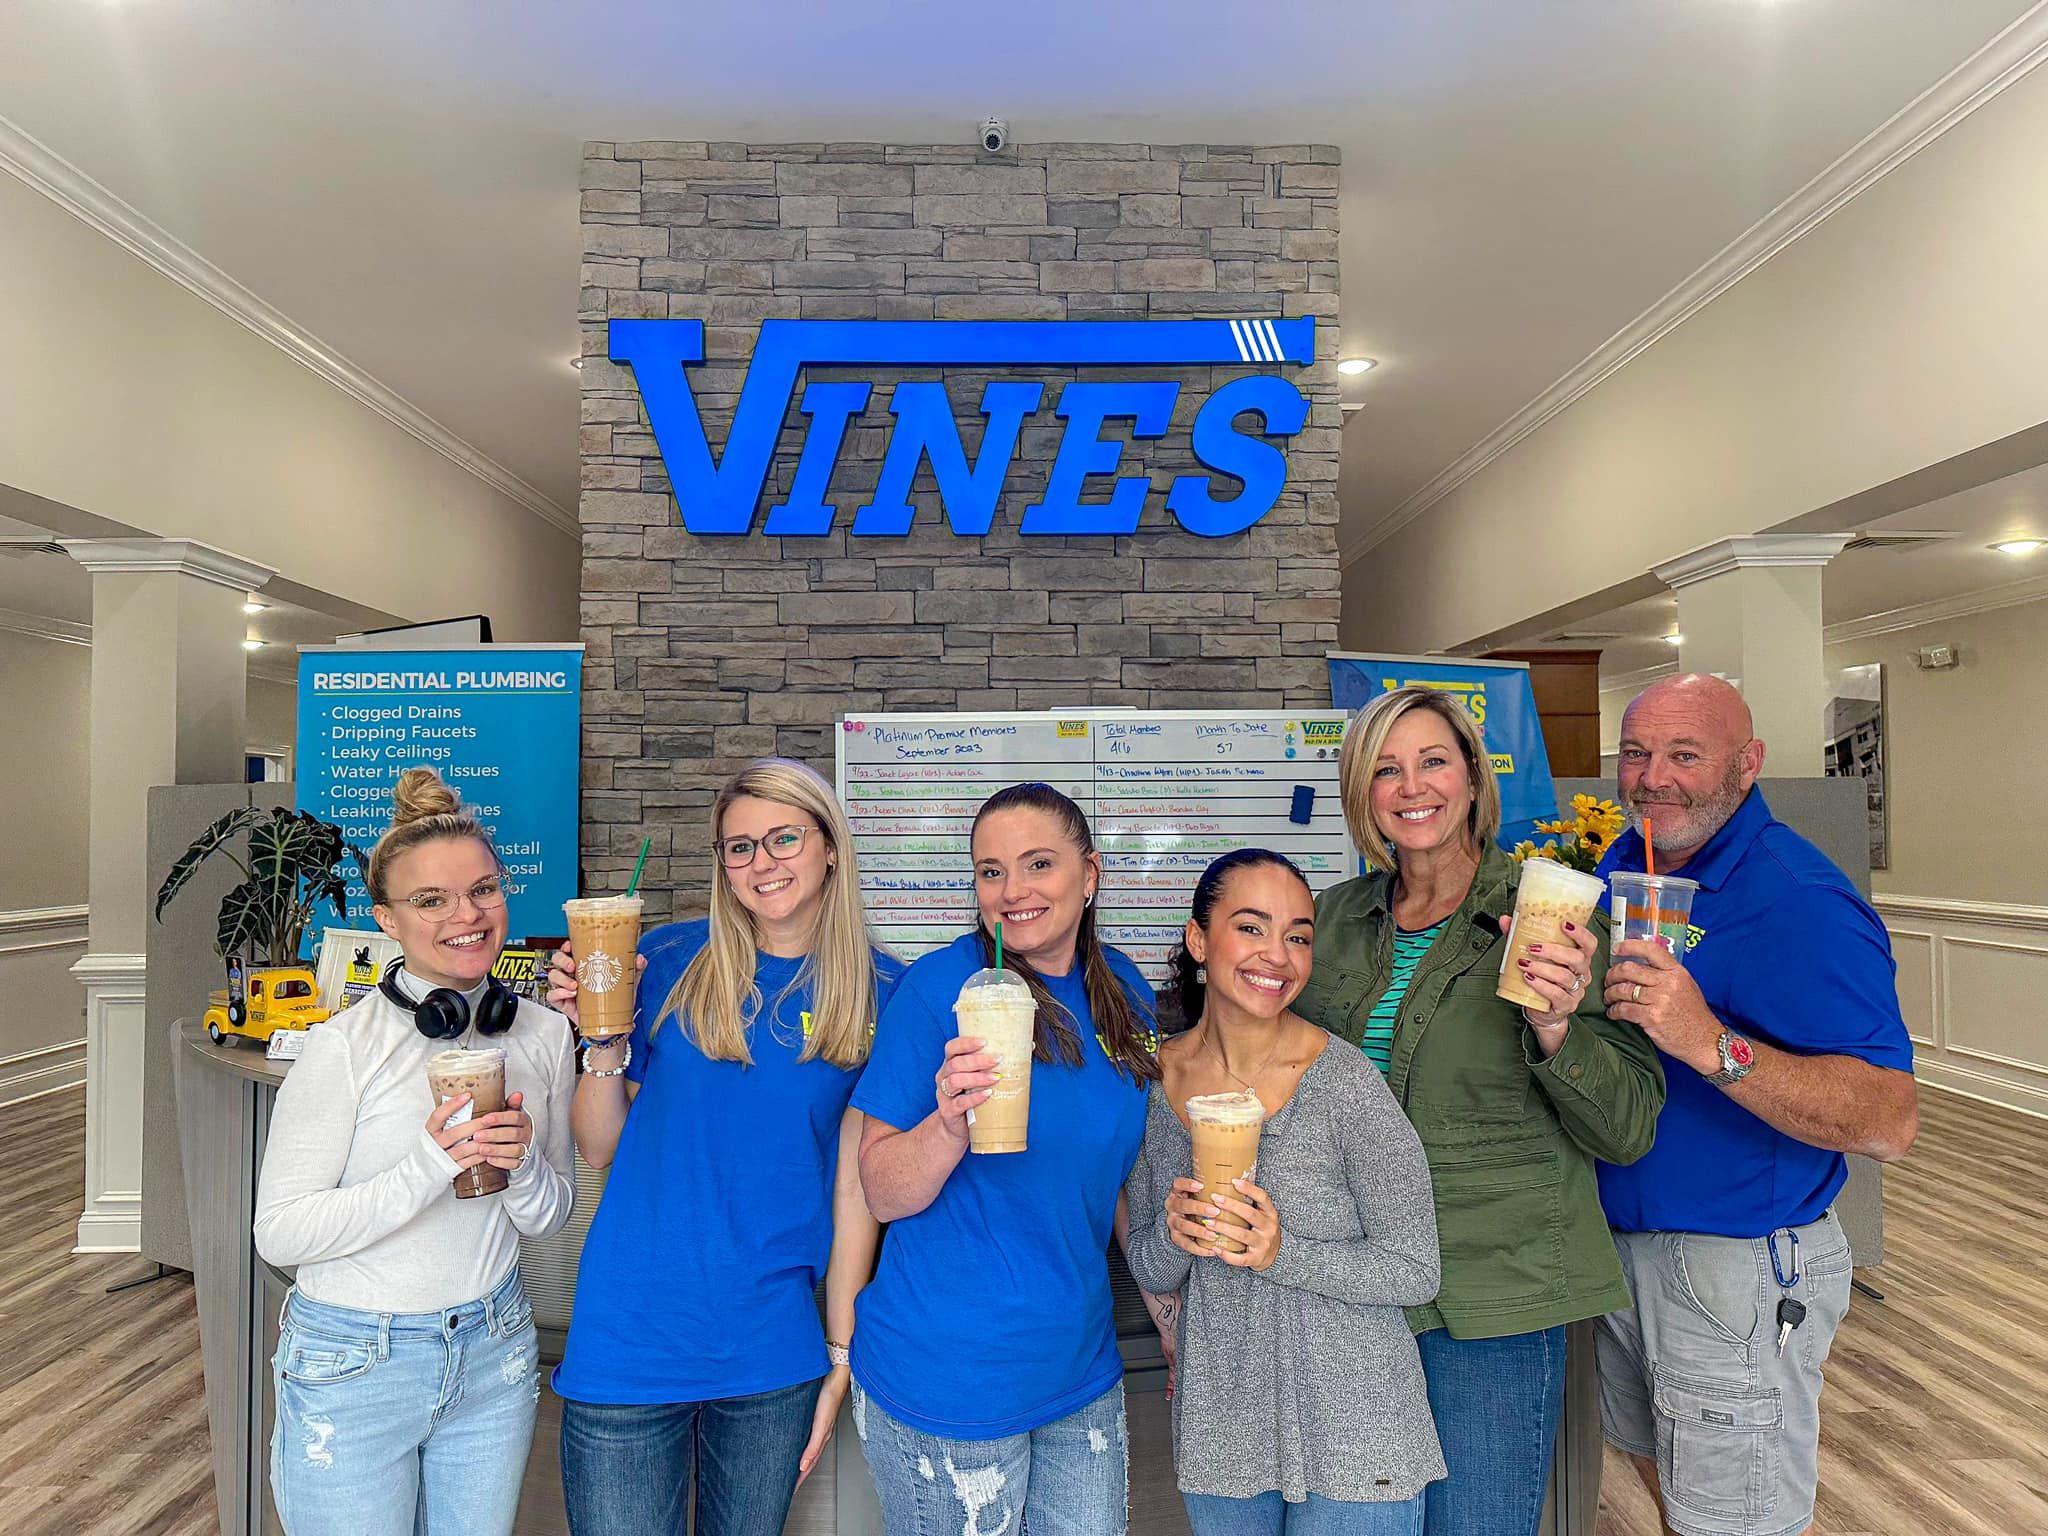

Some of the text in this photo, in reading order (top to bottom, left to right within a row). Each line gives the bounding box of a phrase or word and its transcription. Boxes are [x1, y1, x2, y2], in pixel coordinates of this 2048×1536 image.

[608, 315, 1315, 537] VINES
[314, 671, 566, 689] RESIDENTIAL PLUMBING
[332, 705, 462, 721] Clogged Drains
[332, 725, 477, 741] Dripping Faucets
[1229, 722, 1241, 733] To
[1301, 721, 1344, 735] VINES
[875, 728, 923, 744] Platinum
[332, 744, 451, 761] Leaky Ceilings
[896, 744, 982, 759] September 2023
[1111, 741, 1131, 754] 416
[1217, 743, 1232, 754] 57
[331, 764, 500, 778] Water Her Issues
[330, 785, 396, 800] Clogge
[330, 805, 395, 819] Leaking
[496, 841, 540, 855] nstall
[329, 904, 373, 917] Wate
